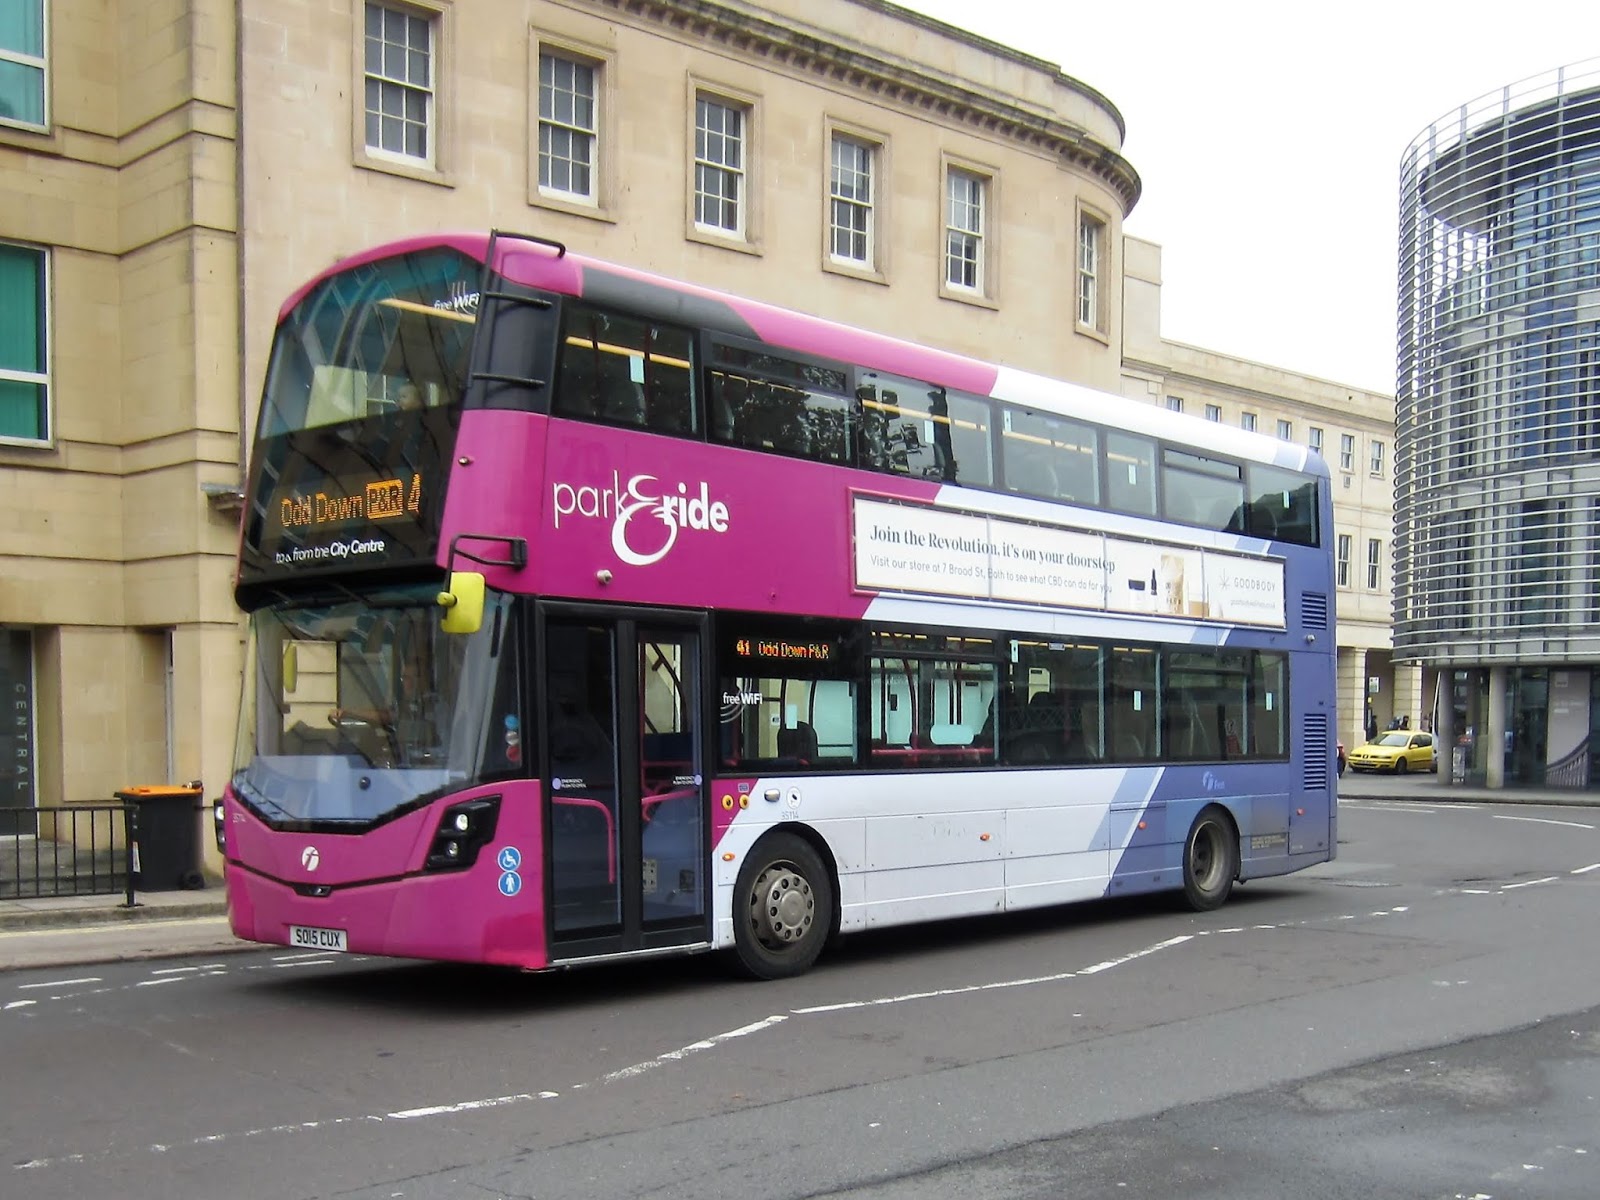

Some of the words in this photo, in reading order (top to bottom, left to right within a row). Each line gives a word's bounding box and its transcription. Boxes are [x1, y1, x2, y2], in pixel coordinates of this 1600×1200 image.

[281, 495, 312, 527] Odd
[315, 492, 363, 523] Down
[368, 483, 402, 516] P&R
[553, 470, 632, 529] park
[662, 482, 730, 533] ride
[275, 552, 285, 564] to
[292, 547, 315, 561] from
[330, 542, 350, 559] City
[350, 539, 385, 555] Centre
[870, 525, 901, 544] Join
[904, 530, 926, 547] the
[1002, 541, 1020, 558] it's
[1022, 548, 1037, 562] on
[1038, 551, 1065, 566] your
[1067, 552, 1115, 574] doorstep
[870, 554, 890, 568] Visit
[892, 559, 908, 570] our
[909, 559, 931, 573] store
[932, 562, 941, 573] at
[942, 562, 947, 574] 7
[949, 563, 973, 577] Broad
[975, 566, 987, 579] St,
[988, 567, 1005, 580] Bath
[1006, 570, 1015, 582] to
[1016, 572, 1028, 583] see
[1029, 574, 1046, 585] what
[1047, 574, 1063, 588] CBD
[1064, 579, 1077, 589] can
[1078, 580, 1087, 590] do
[1088, 580, 1099, 592] for
[1234, 577, 1276, 591] GOODBODY
[737, 640, 750, 655] 41
[759, 641, 778, 656] Odd
[781, 643, 806, 658] Down
[808, 644, 829, 659] P&R
[723, 692, 740, 703] free
[740, 692, 763, 705] WiFi
[16, 683, 28, 790] CENTRAL
[296, 929, 318, 945] SO15
[320, 931, 340, 947] CUX
